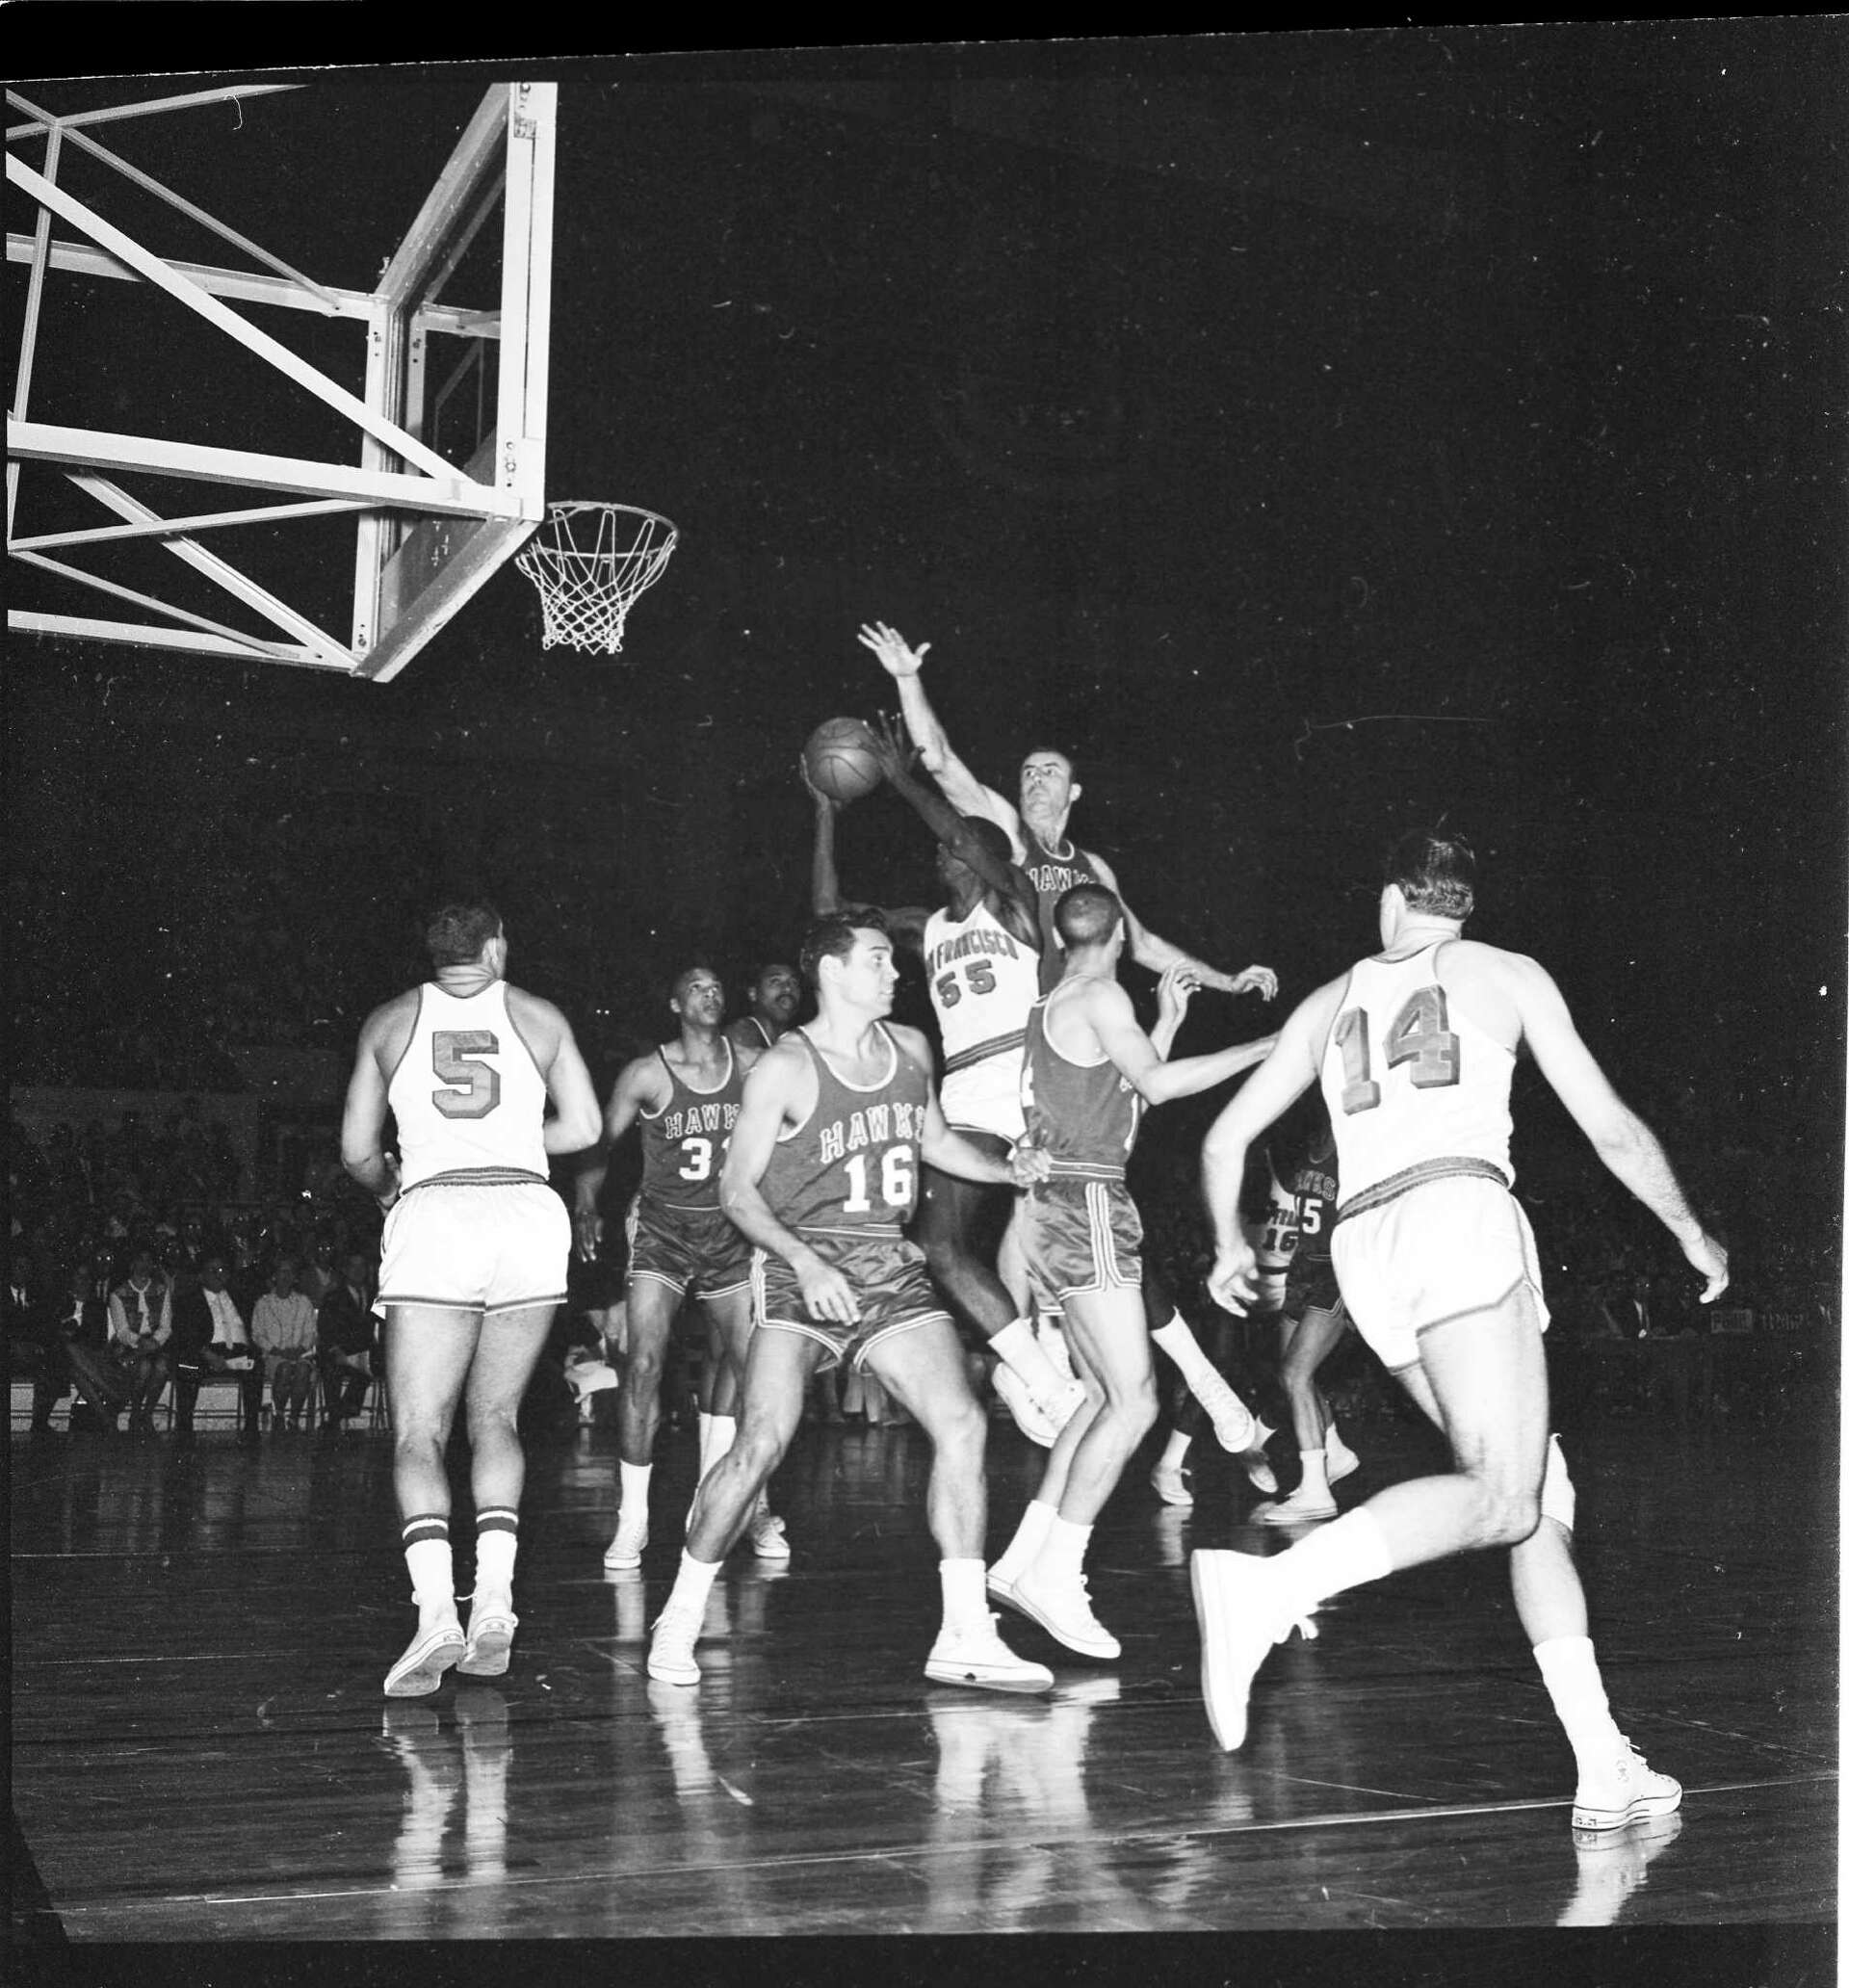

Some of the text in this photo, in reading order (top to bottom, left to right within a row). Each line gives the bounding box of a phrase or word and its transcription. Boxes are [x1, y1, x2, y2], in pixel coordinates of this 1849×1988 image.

[936, 958, 997, 1009] 55
[431, 1030, 501, 1119] 5
[1333, 983, 1461, 1116] 14
[664, 1103, 740, 1139] HAWK
[679, 1138, 730, 1181] 3
[843, 1144, 914, 1213] 16
